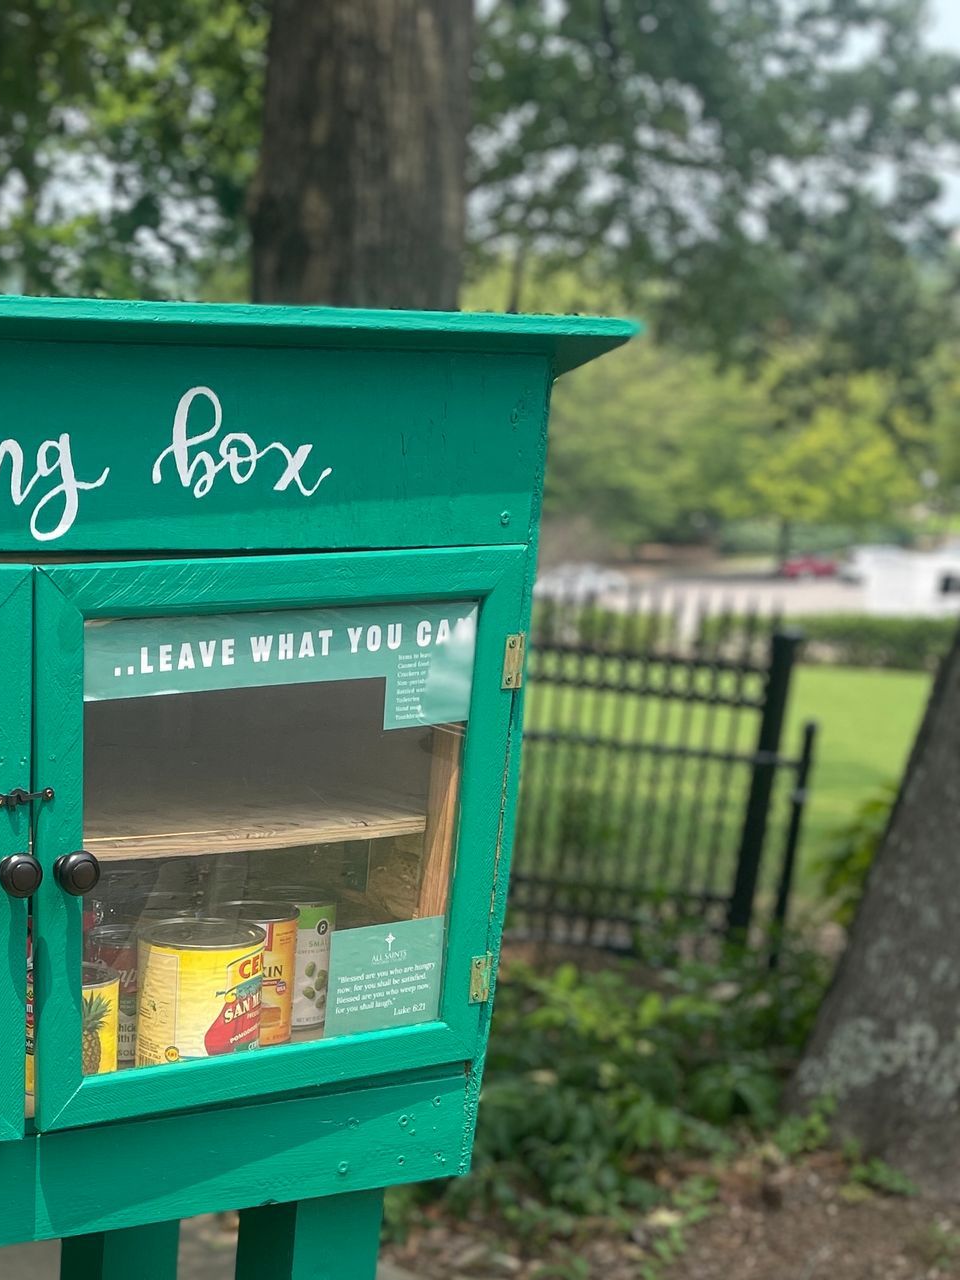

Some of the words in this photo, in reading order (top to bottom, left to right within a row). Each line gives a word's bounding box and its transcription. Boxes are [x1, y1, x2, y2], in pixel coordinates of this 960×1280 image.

[152, 386, 332, 499] box
[250, 629, 333, 662] WHAT
[346, 623, 402, 651] YOU
[384, 951, 407, 960] SAINTS
[378, 971, 388, 979] you
[414, 963, 435, 972] hungry
[336, 995, 360, 1004] Blessed
[400, 986, 416, 994] weep
[224, 997, 250, 1024] SAN
[346, 1006, 358, 1014] you
[360, 1002, 374, 1010] shall
[394, 1006, 411, 1016] Luke
[412, 1004, 426, 1013] 6:21
